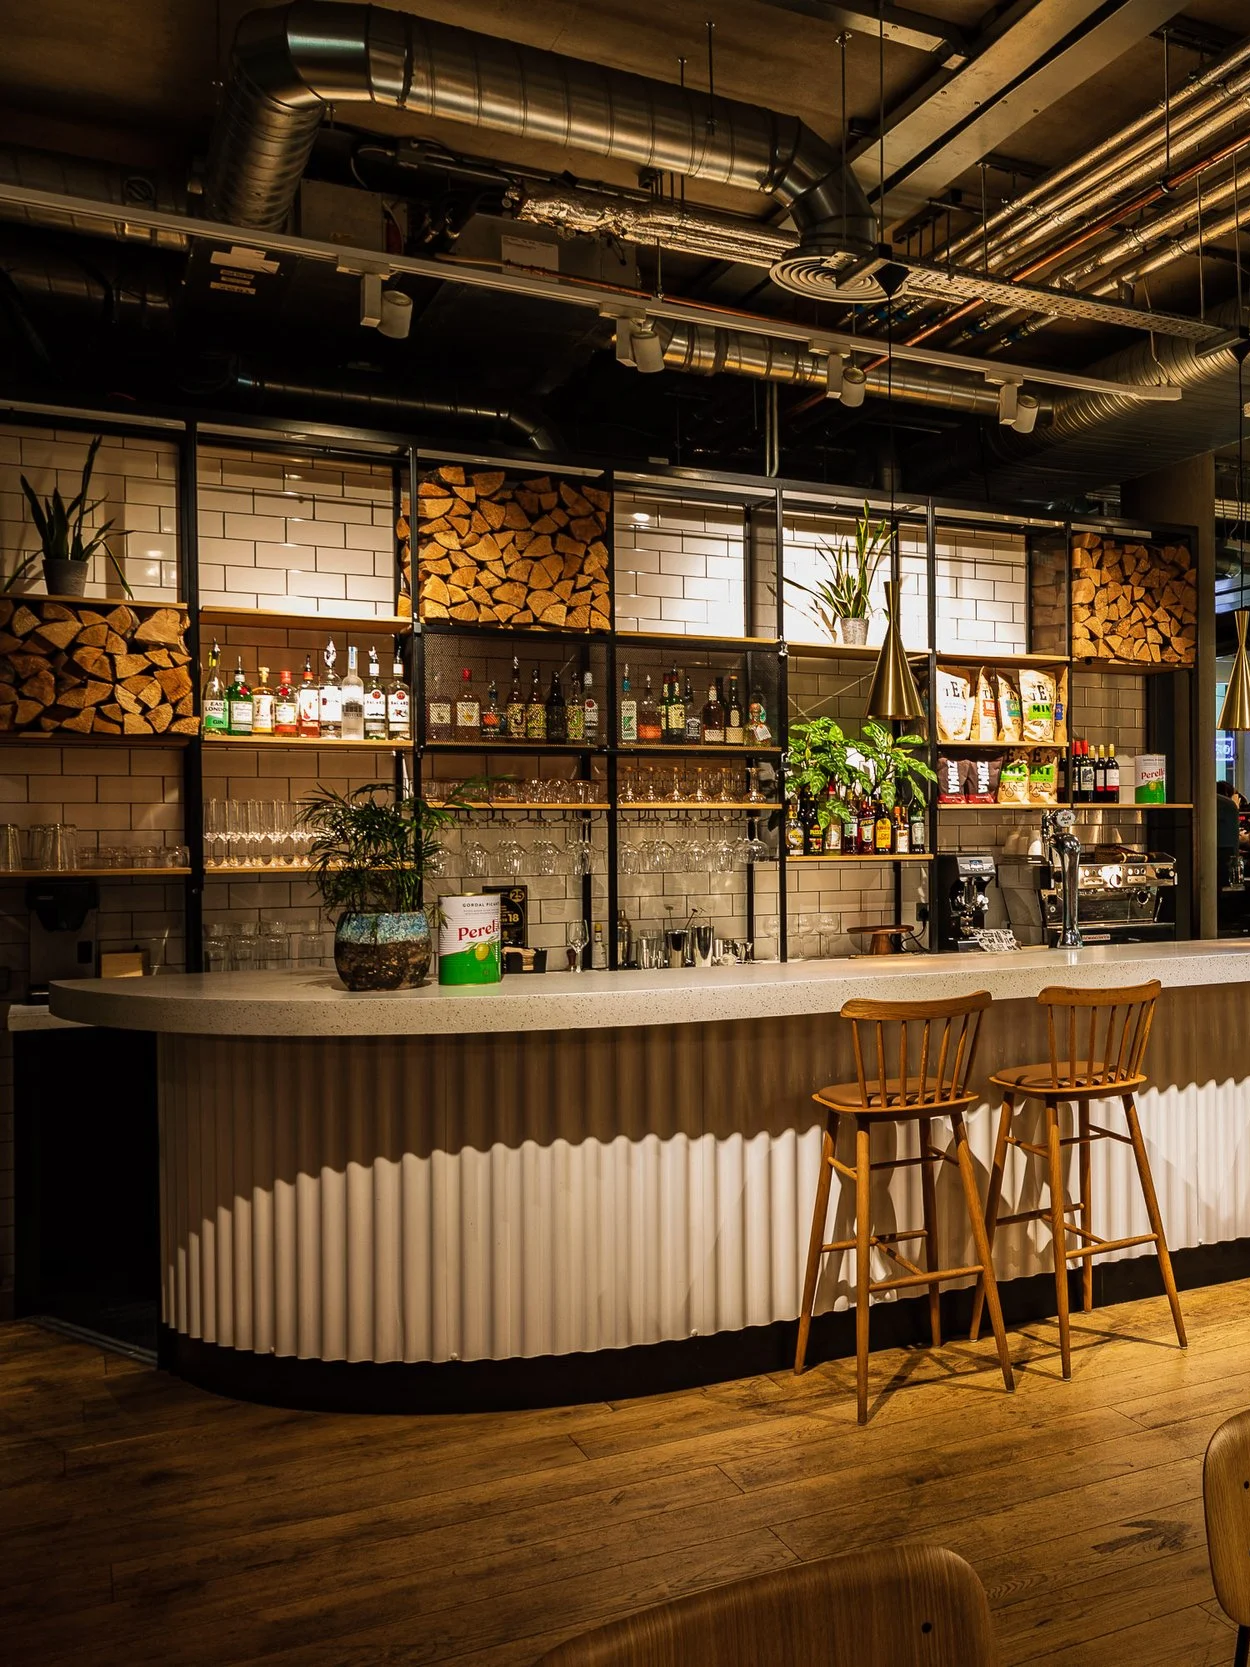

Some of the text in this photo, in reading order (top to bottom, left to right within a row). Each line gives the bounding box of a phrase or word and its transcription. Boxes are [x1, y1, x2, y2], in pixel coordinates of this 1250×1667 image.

[946, 760, 960, 793] ZUMA
[976, 761, 990, 793] ZUMA
[511, 891, 523, 900] 25
[507, 913, 519, 923] 18
